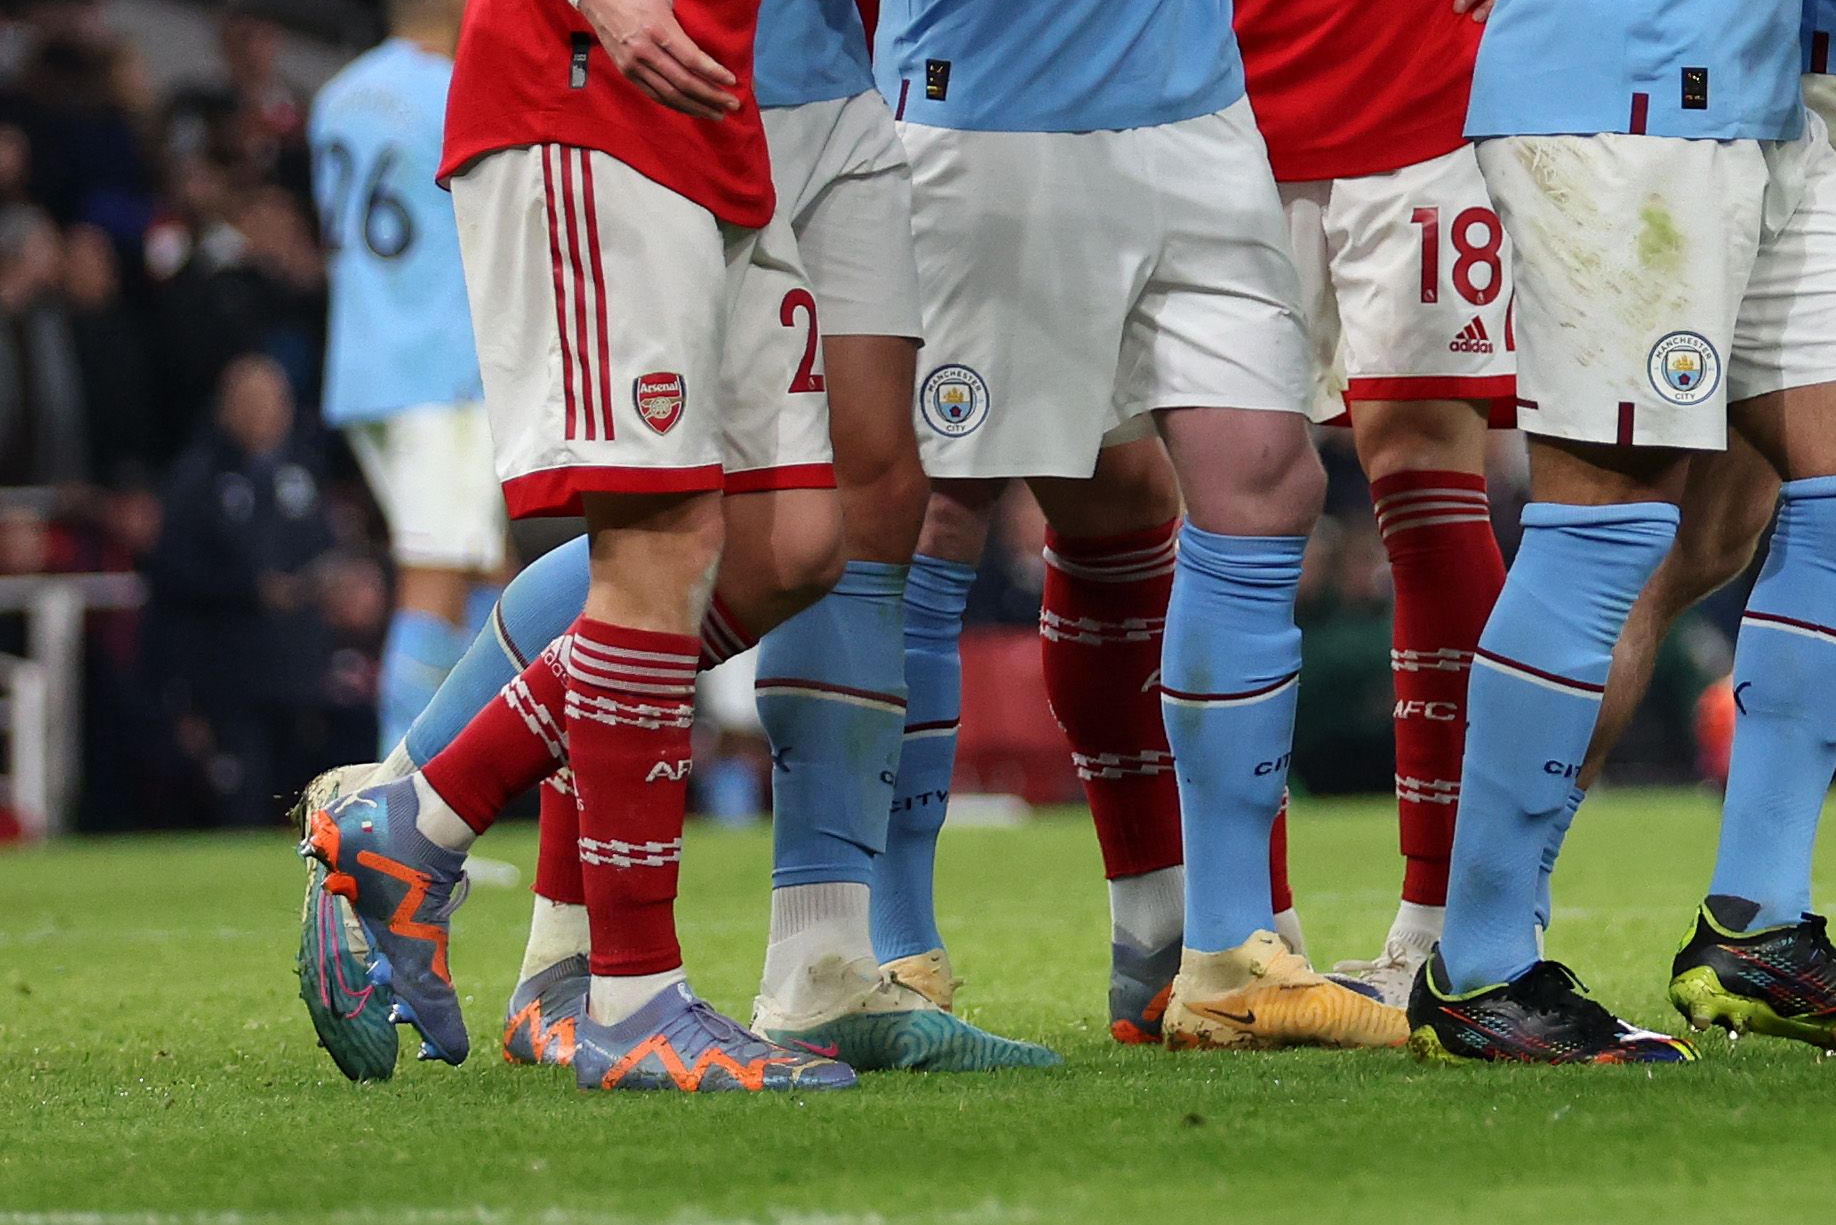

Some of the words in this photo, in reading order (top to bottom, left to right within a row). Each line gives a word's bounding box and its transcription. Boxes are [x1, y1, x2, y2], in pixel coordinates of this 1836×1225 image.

[1410, 206, 1504, 307] 18
[1449, 339, 1494, 354] adidas
[1655, 337, 1713, 360] MANCHESTER
[640, 379, 680, 394] Arsenal
[927, 370, 982, 393] MANCHESTER
[946, 424, 966, 432] CITY
[1392, 698, 1459, 722] AFC
